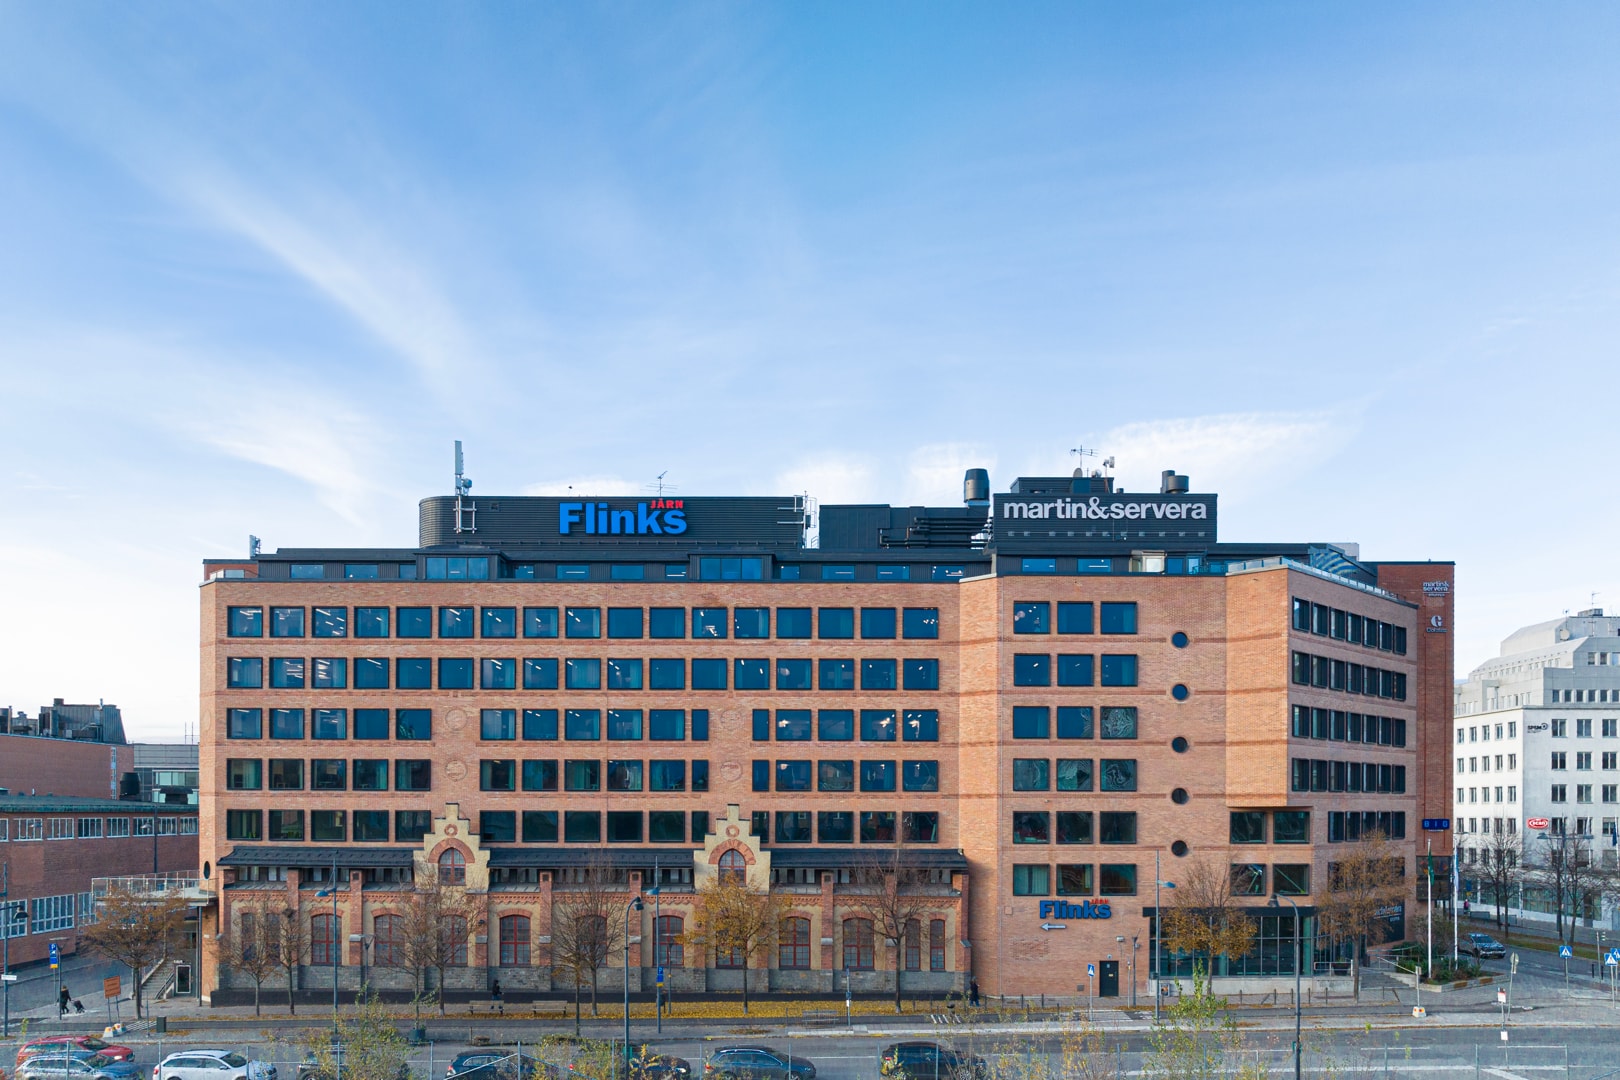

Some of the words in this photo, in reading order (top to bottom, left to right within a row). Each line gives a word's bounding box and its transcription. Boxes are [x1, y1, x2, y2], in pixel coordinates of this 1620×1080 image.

[650, 498, 684, 509] JÄRN
[1003, 497, 1207, 520] martin&servera
[559, 502, 687, 534] Flinks
[1039, 900, 1112, 919] Flinks
